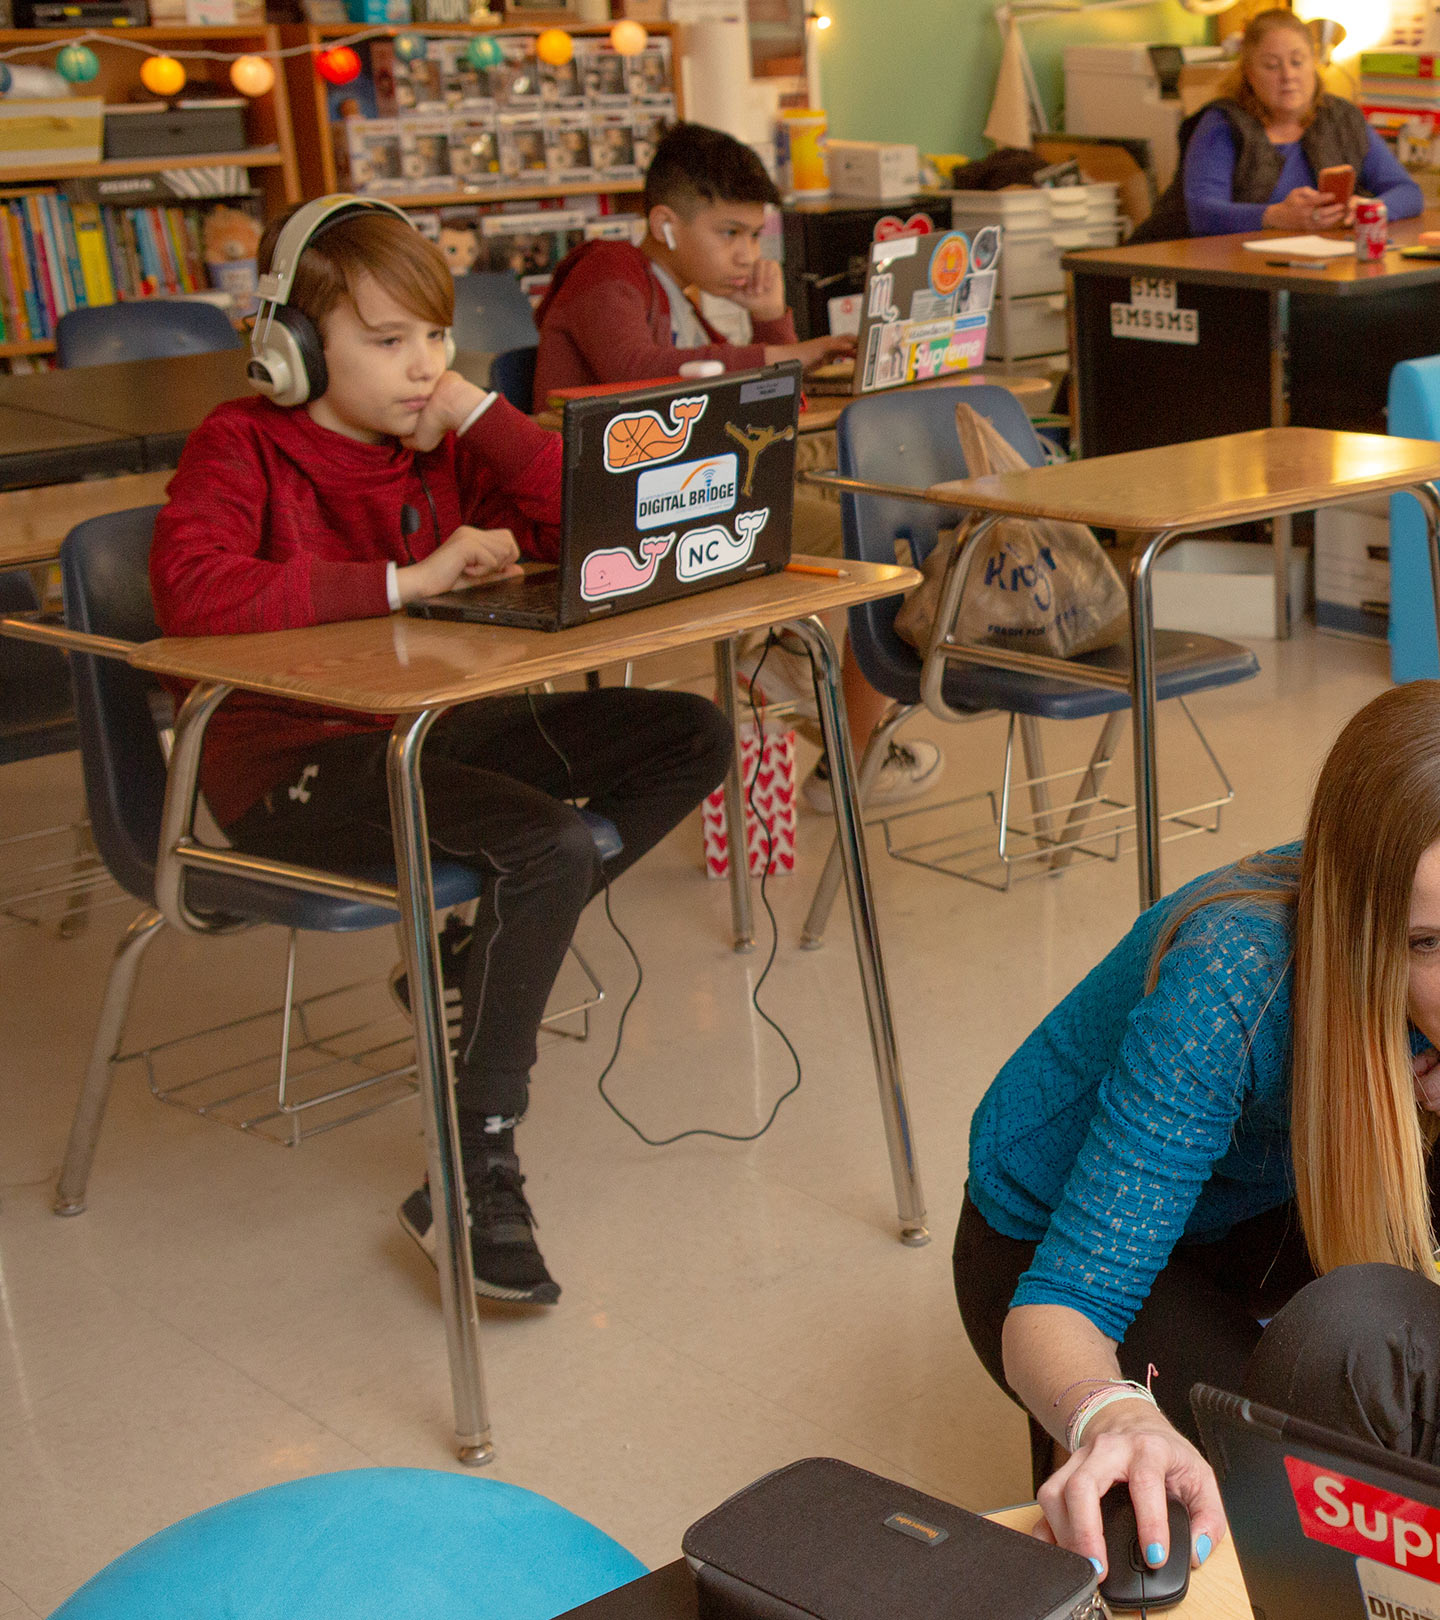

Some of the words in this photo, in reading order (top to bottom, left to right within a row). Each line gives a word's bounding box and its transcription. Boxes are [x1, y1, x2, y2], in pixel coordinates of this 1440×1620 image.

[1132, 278, 1172, 299] SMS
[1111, 307, 1194, 332] SMSSMS
[912, 340, 981, 374] Supreme
[639, 494, 686, 518] DIGITAL
[688, 540, 720, 568] NC
